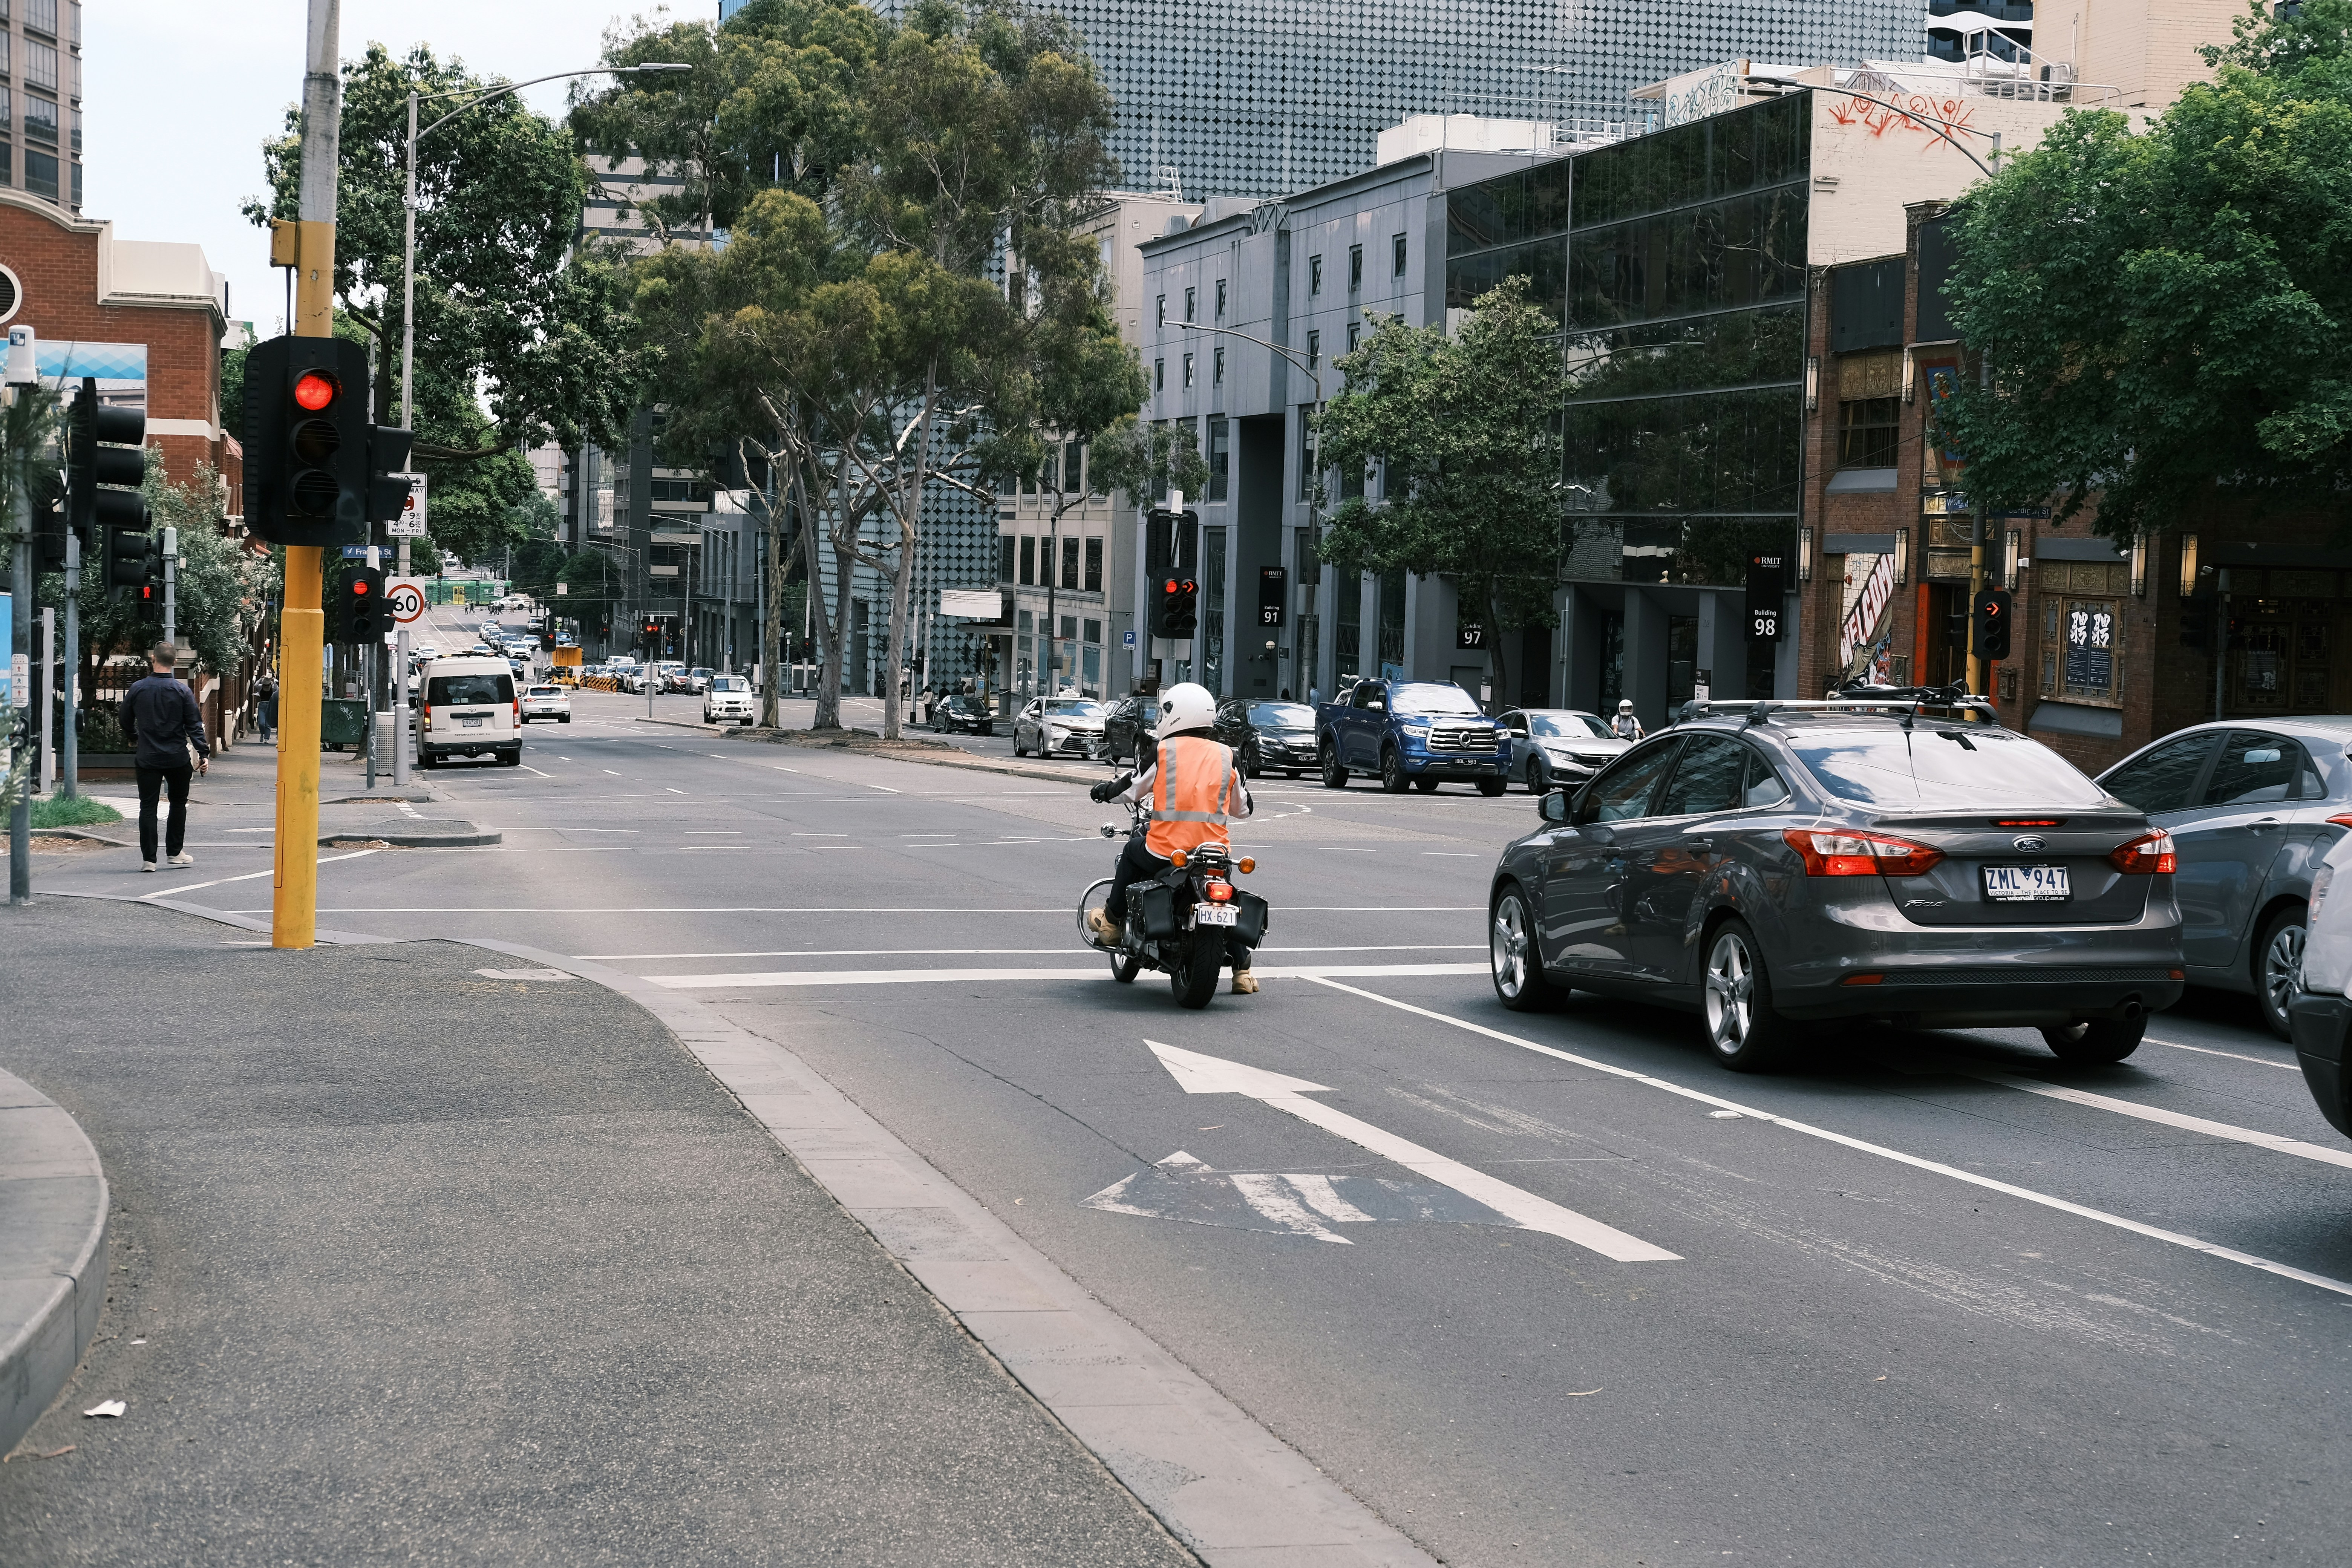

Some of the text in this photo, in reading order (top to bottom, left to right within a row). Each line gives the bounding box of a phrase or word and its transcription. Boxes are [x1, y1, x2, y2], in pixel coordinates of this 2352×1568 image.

[394, 595, 417, 612] 60
[1265, 611, 1277, 623] 91
[1755, 619, 1775, 635] 98
[1126, 634, 1133, 642] P
[1464, 631, 1481, 644] 97
[2021, 841, 2041, 849] Ford
[1986, 869, 2066, 890] ZML 947
